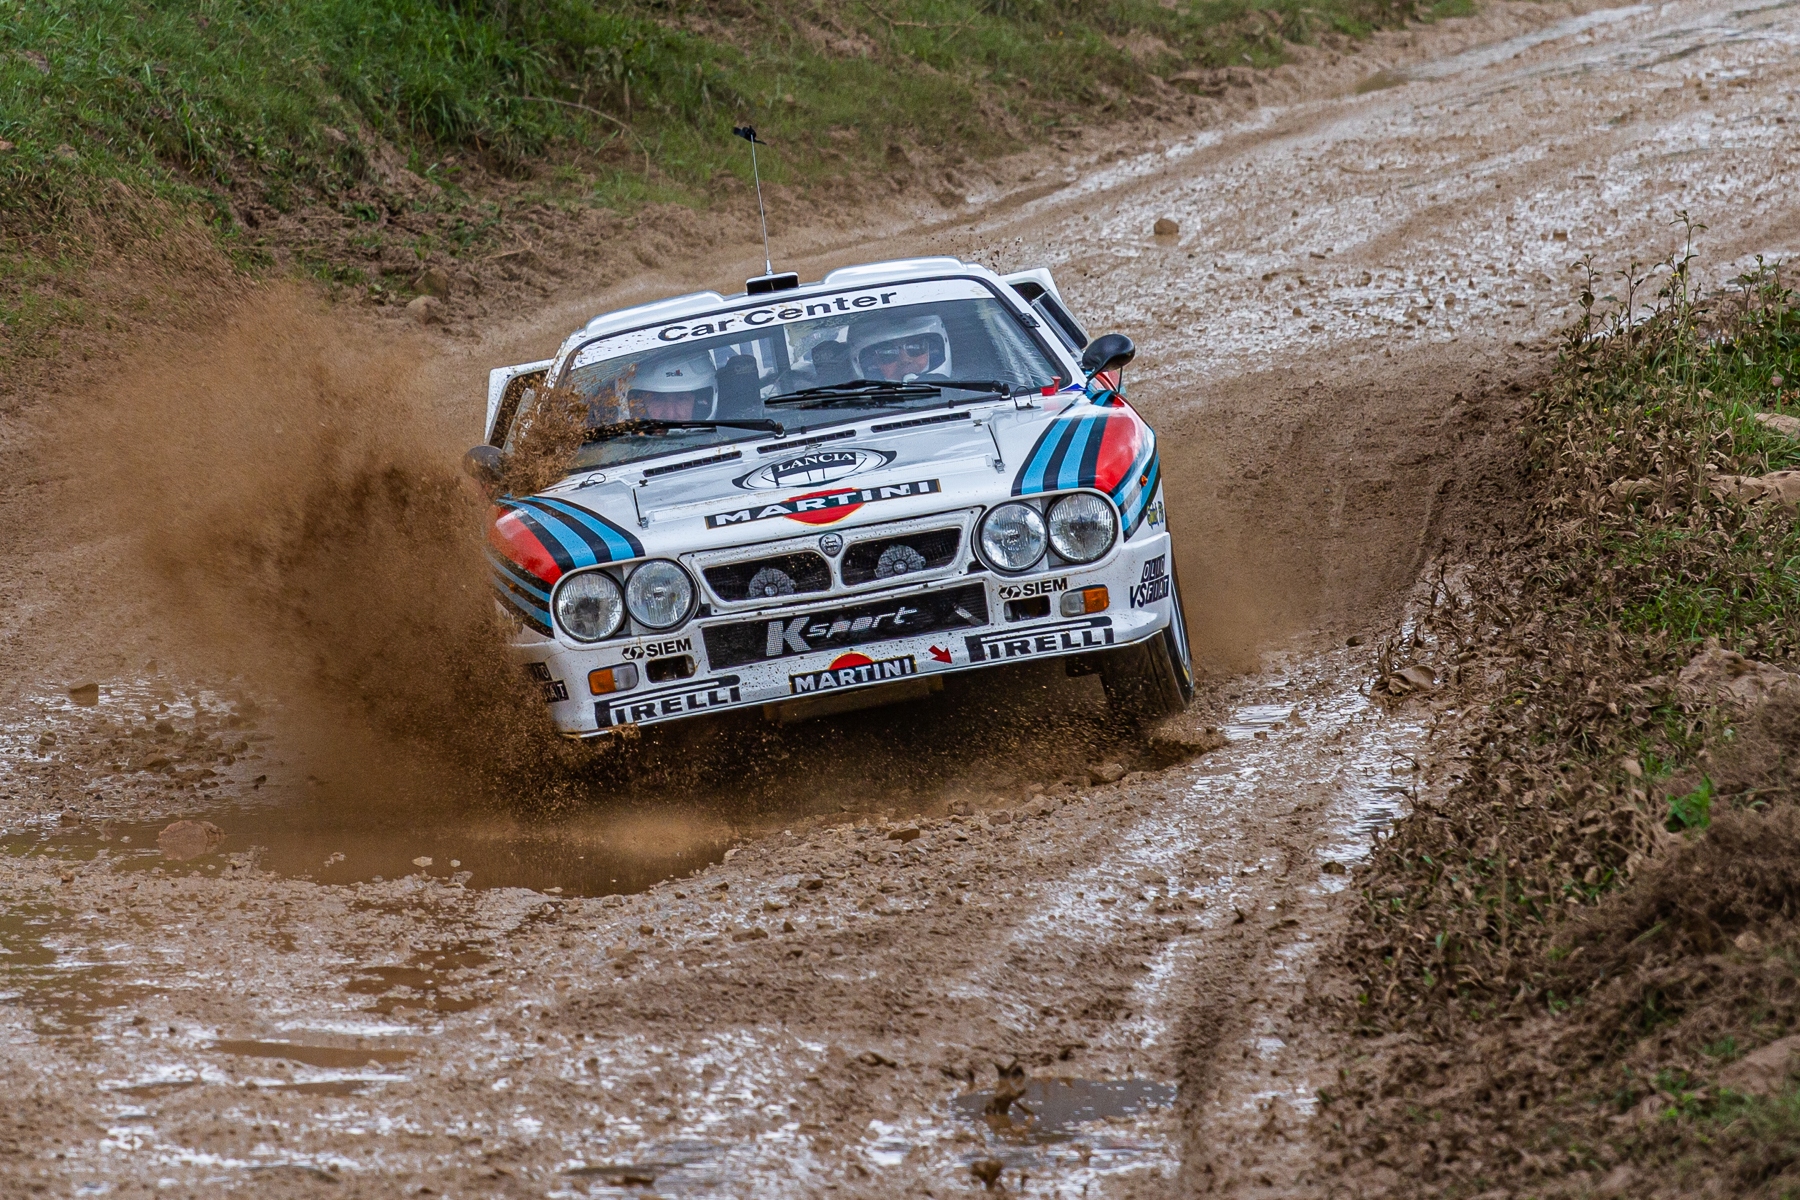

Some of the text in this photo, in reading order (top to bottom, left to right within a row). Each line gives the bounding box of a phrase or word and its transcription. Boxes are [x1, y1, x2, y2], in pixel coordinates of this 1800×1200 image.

[657, 291, 897, 342] Car Center
[777, 452, 856, 473] LANCIA
[715, 481, 930, 526] MARTINI
[1022, 578, 1068, 597] SIEM
[646, 638, 692, 658] SIEM
[964, 616, 1114, 663] PIRELLI
[794, 658, 913, 693] MARTINI
[594, 674, 741, 728] PIRELLI
